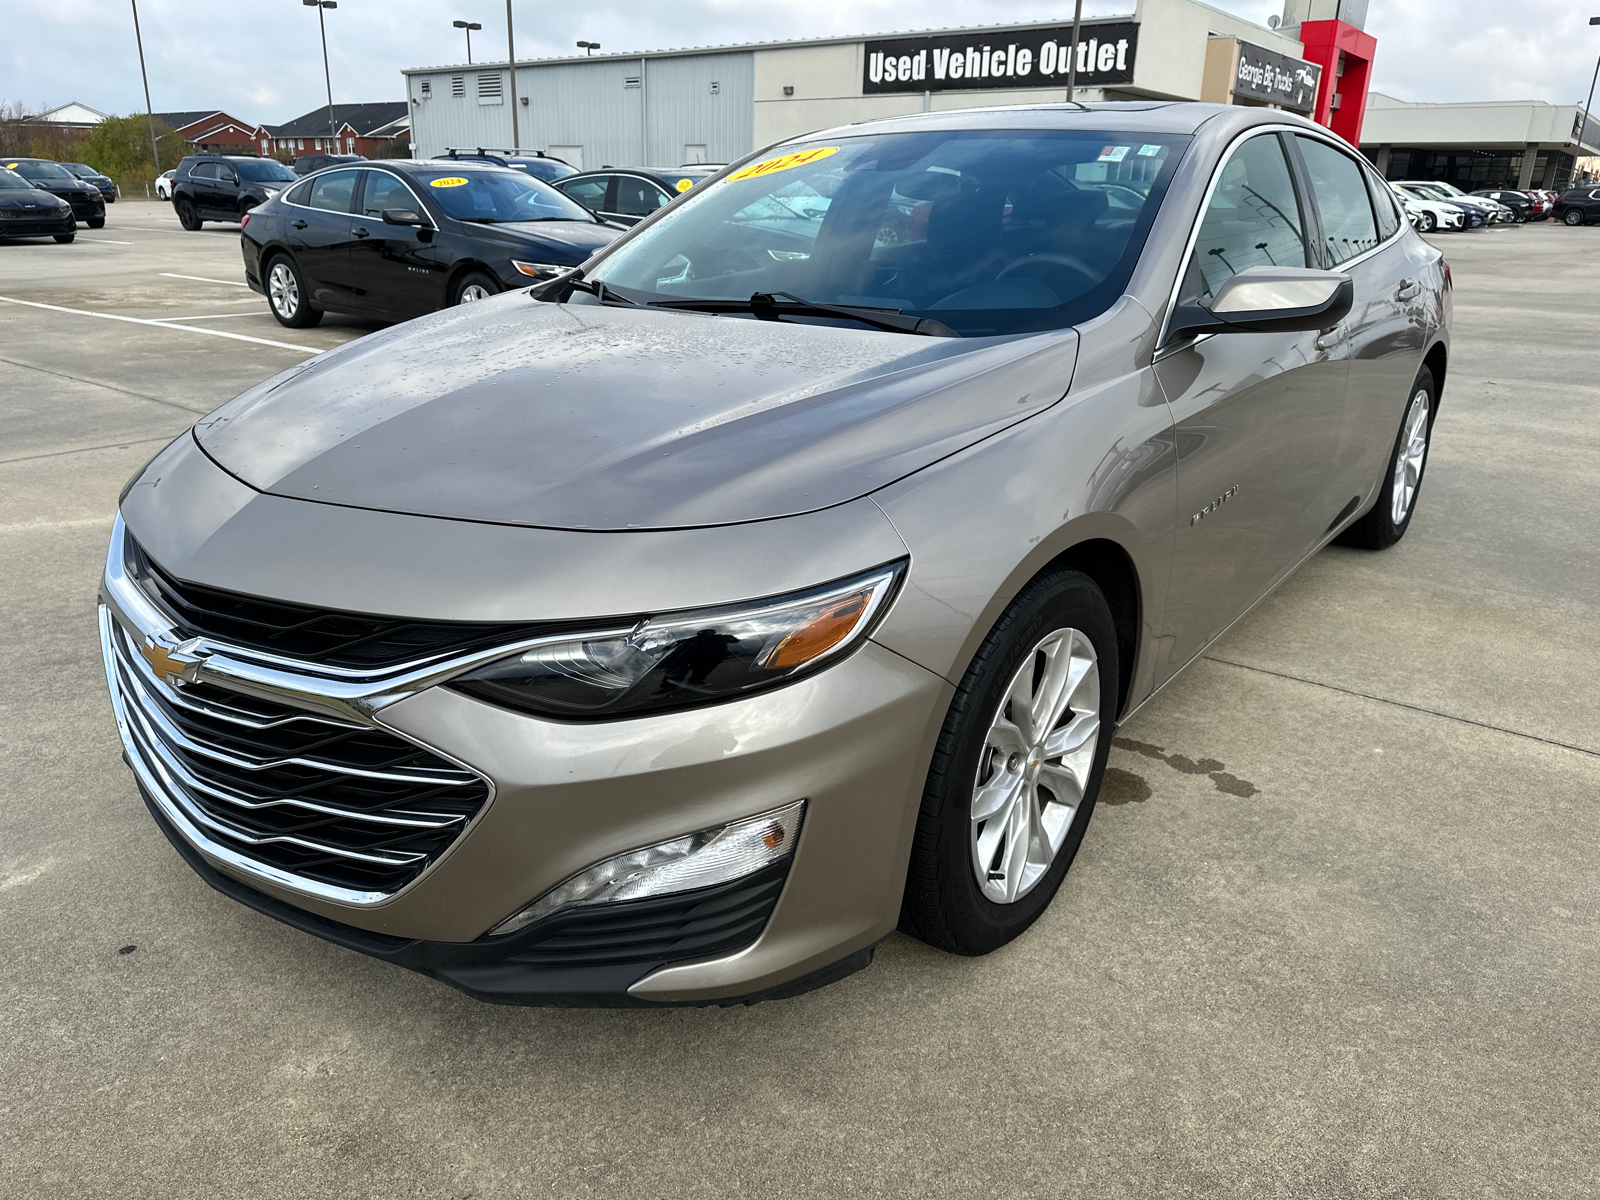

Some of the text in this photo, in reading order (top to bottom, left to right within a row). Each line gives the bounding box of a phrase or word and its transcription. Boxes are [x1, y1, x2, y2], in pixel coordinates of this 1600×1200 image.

[869, 39, 1129, 83] Used Vehicle Outlet
[1238, 56, 1294, 93] Georgia Big Trucks
[437, 178, 462, 187] 2024
[735, 148, 825, 180] 2024
[1190, 484, 1239, 527] MALIBU
